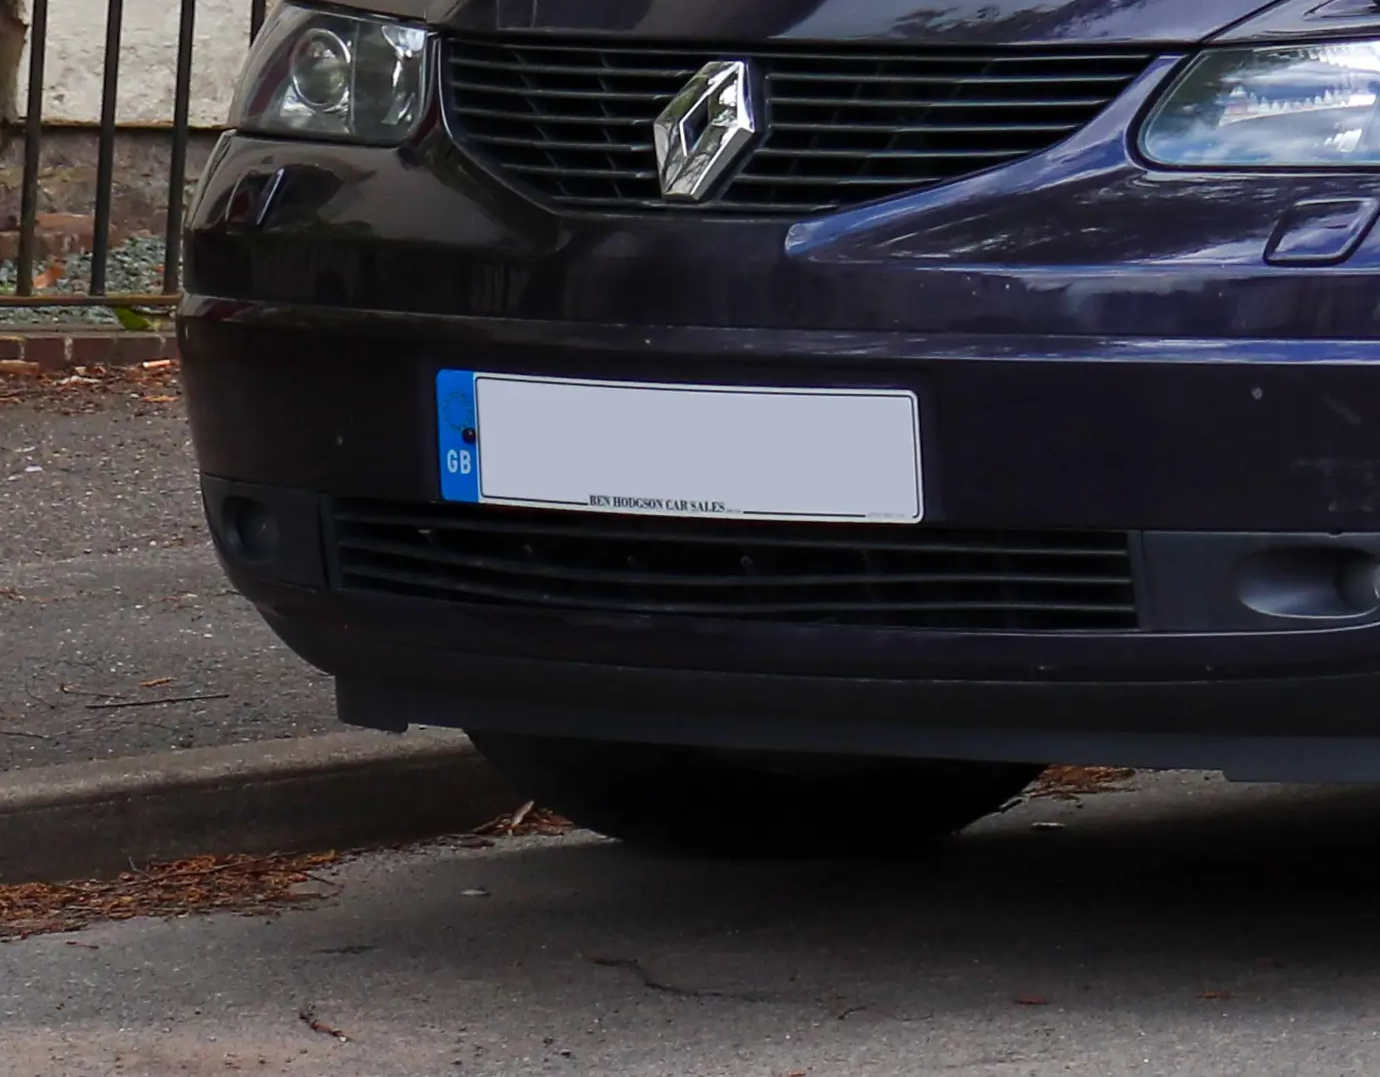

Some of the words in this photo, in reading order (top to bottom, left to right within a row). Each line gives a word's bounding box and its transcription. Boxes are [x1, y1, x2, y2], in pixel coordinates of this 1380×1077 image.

[447, 449, 471, 474] GB
[589, 495, 610, 507] BEN
[613, 496, 664, 510] HODGSON
[665, 499, 688, 511] CAR
[690, 501, 725, 513] SALES
